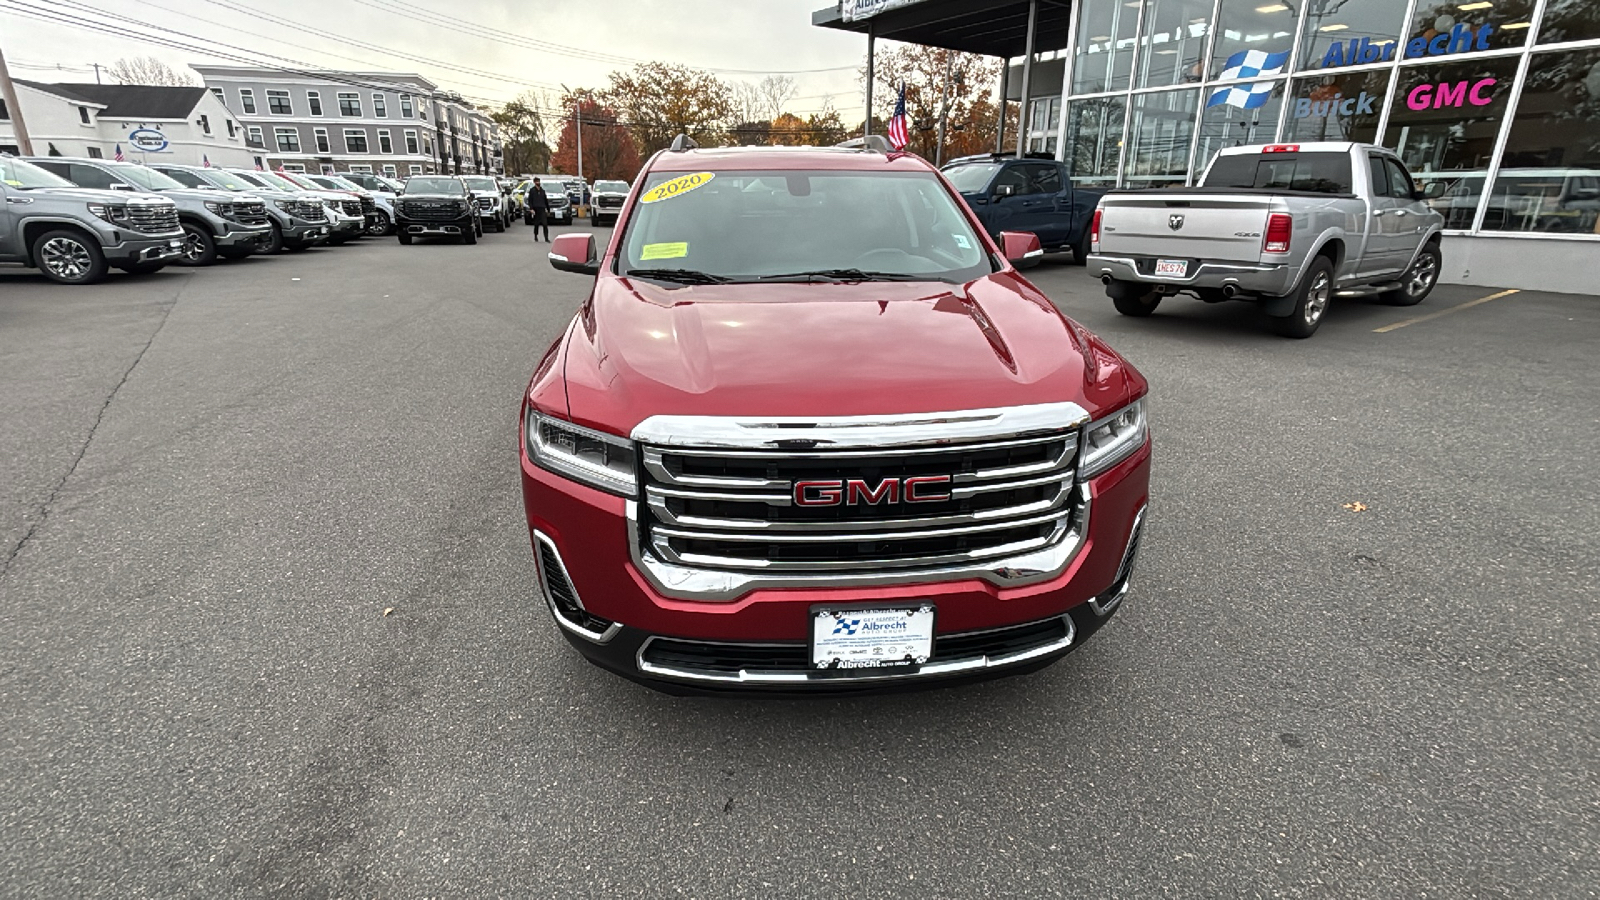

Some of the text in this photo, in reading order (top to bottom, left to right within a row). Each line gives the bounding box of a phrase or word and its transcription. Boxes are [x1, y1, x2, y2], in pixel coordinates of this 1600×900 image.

[1321, 22, 1494, 68] Albrecht
[1294, 91, 1377, 119] Buick
[1406, 78, 1498, 111] GMC
[655, 174, 702, 199] 2020
[793, 474, 951, 507] GMC
[862, 621, 907, 631] Albrecht
[837, 659, 881, 669] Albrecht
